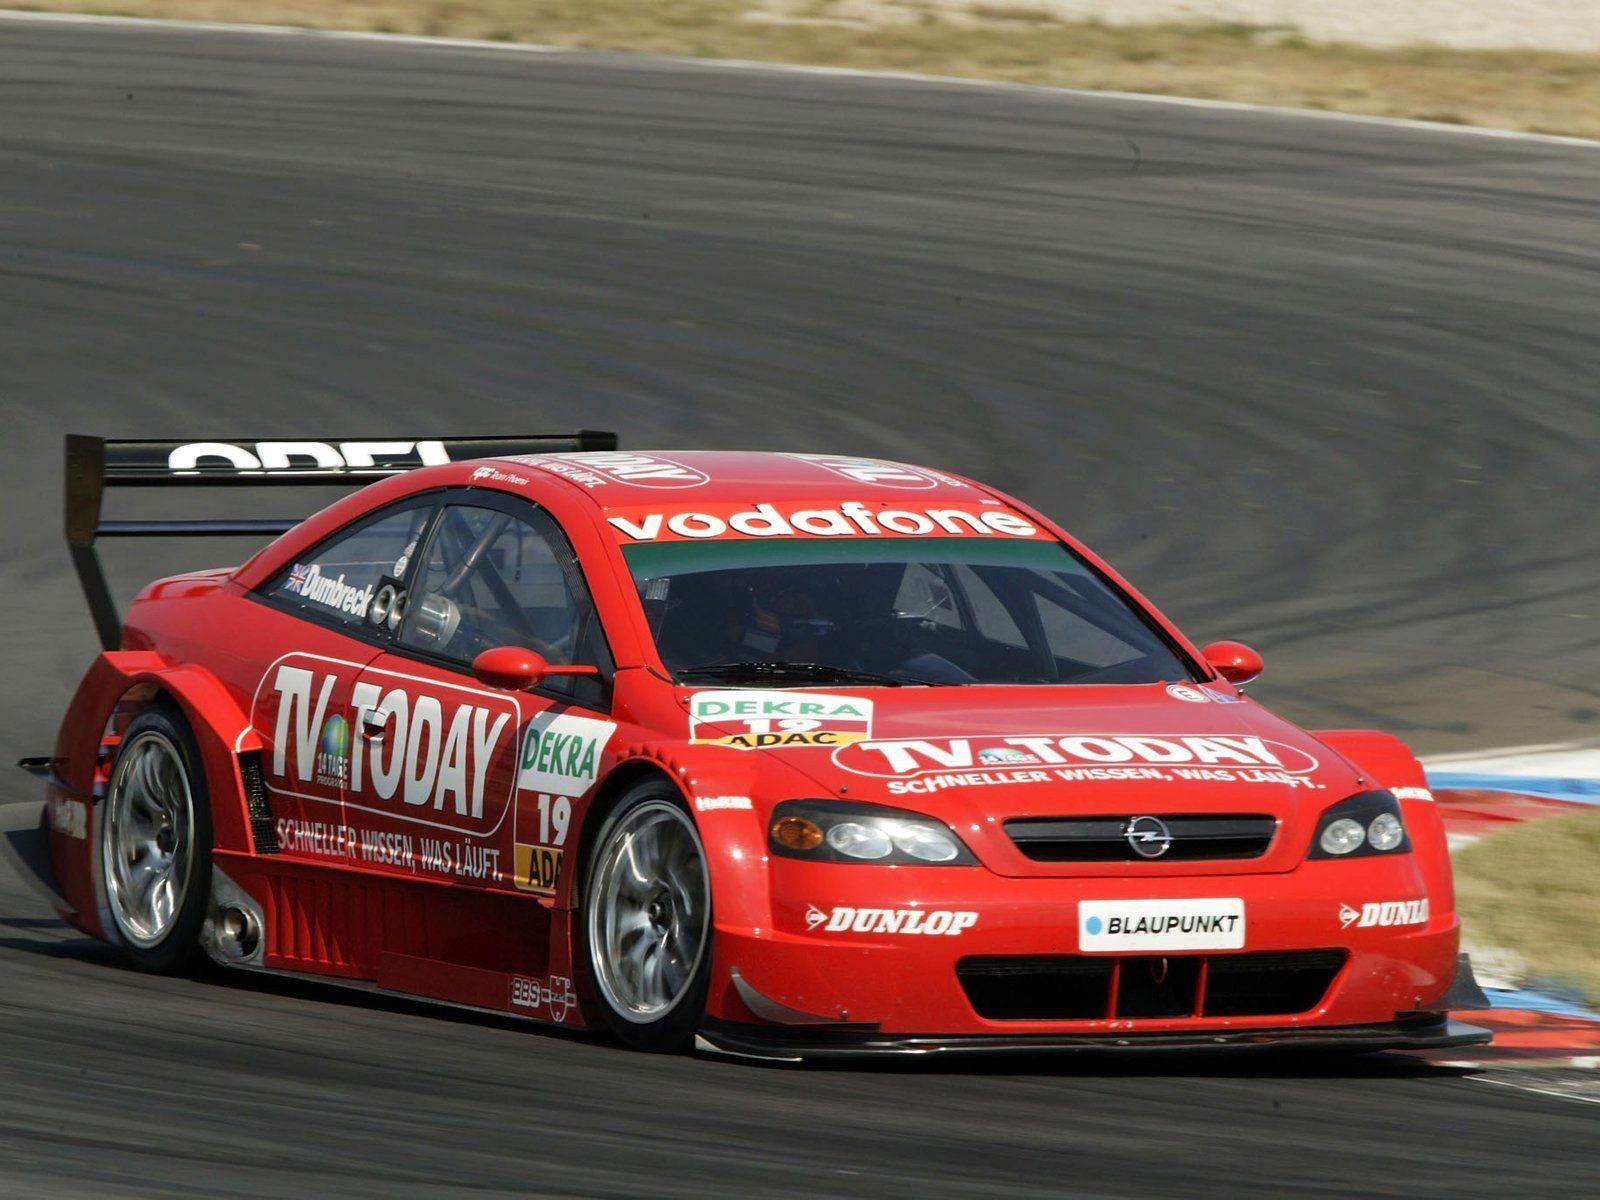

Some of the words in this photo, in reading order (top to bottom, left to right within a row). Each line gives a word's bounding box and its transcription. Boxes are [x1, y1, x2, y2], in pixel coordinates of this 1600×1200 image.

[606, 501, 1038, 539] vodafone
[300, 564, 374, 618] Dumbreck
[698, 701, 864, 717] DEKRA
[273, 665, 337, 781] TV
[351, 681, 512, 819] TODAY
[522, 728, 597, 780] DEKRA
[725, 732, 838, 748] ADAC
[858, 739, 973, 773] TV
[1003, 736, 1284, 768] TODAY
[886, 770, 1053, 794] SCHNELLER
[1054, 767, 1173, 781] WISSEN,
[1172, 768, 1237, 781] WAS
[537, 793, 572, 846] 19
[276, 817, 357, 859] SCHNELLER
[360, 828, 416, 874] WISSEN,
[420, 837, 451, 873] WAS
[455, 838, 503, 881] LÄUFT.
[824, 906, 979, 935] DUNLOP
[1107, 915, 1239, 935] BLAUPUNKT
[512, 978, 541, 1008] BBS
